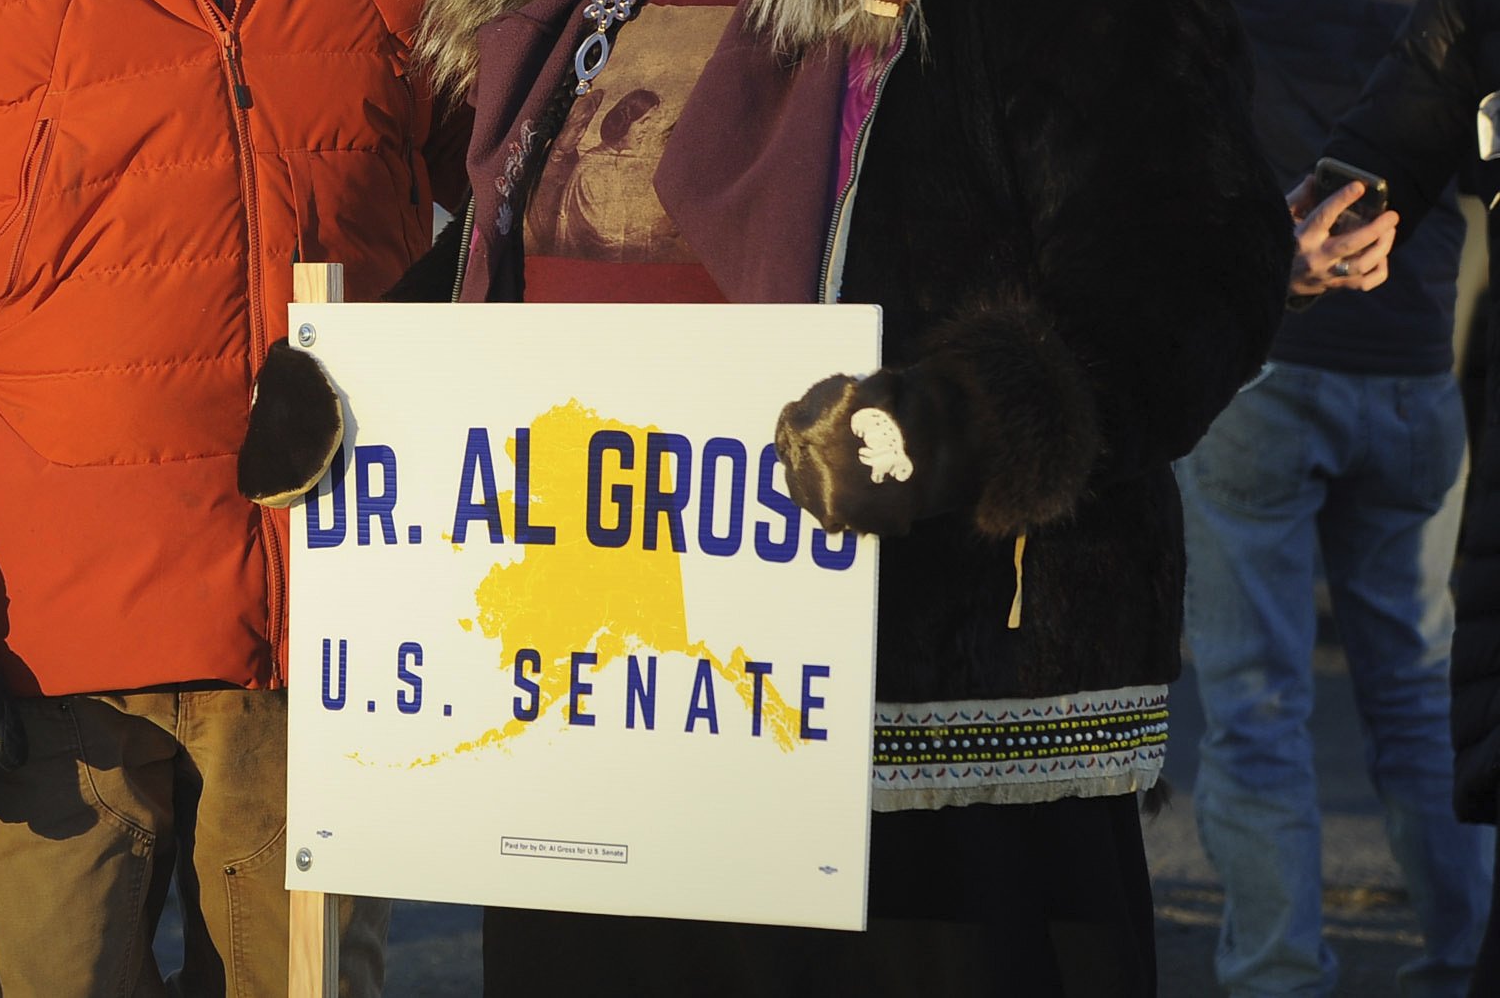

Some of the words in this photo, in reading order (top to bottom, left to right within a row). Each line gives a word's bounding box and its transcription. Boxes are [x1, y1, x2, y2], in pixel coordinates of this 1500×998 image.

[451, 427, 556, 546] AL
[321, 638, 452, 717] U.S.
[513, 648, 830, 741] SENATE
[557, 845, 576, 854] Gross
[601, 848, 624, 857] Senate
